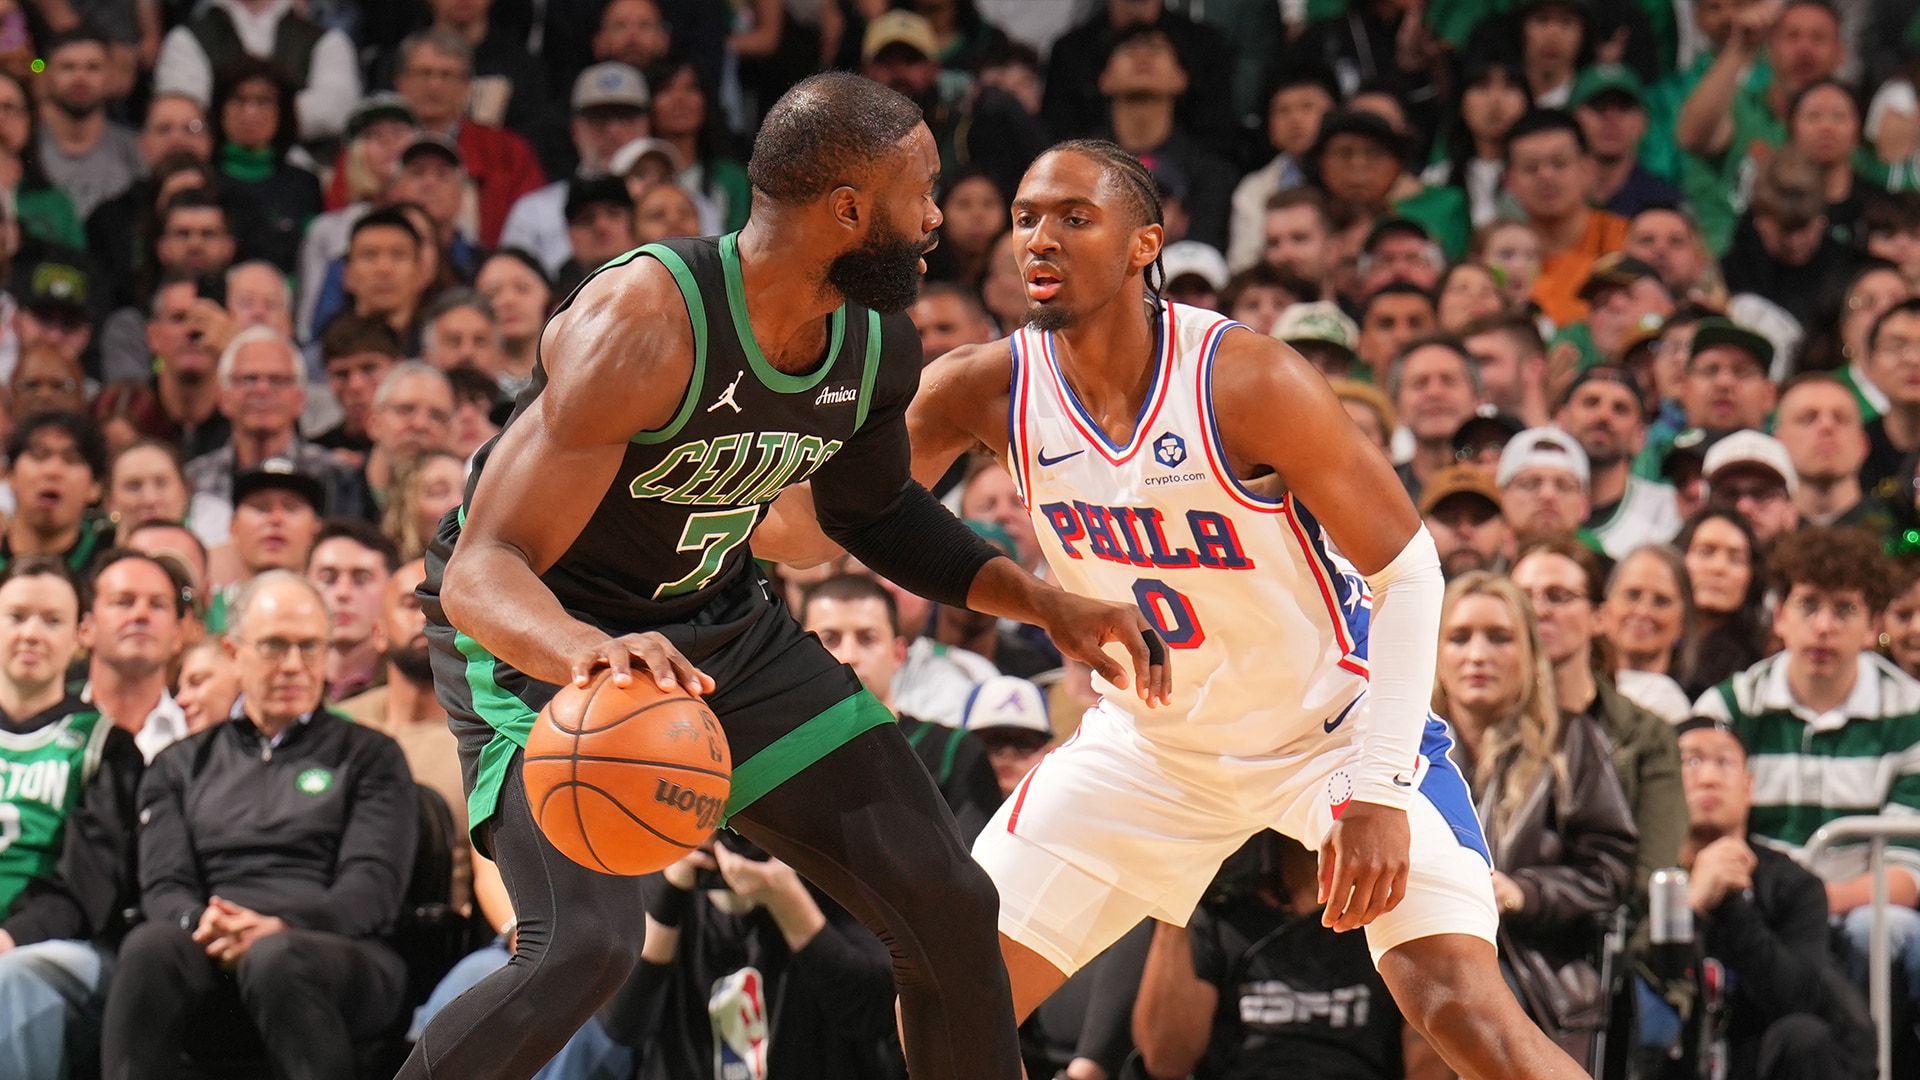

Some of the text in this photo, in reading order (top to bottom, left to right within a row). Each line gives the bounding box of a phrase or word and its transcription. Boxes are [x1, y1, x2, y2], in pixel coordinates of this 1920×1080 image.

[815, 386, 857, 405] Amica
[1145, 471, 1206, 486] crypto.com
[650, 504, 760, 601] 7
[1039, 500, 1256, 570] PHILA
[1131, 578, 1206, 649] 0
[654, 776, 724, 830] ilson
[1238, 979, 1371, 1028] ESPN
